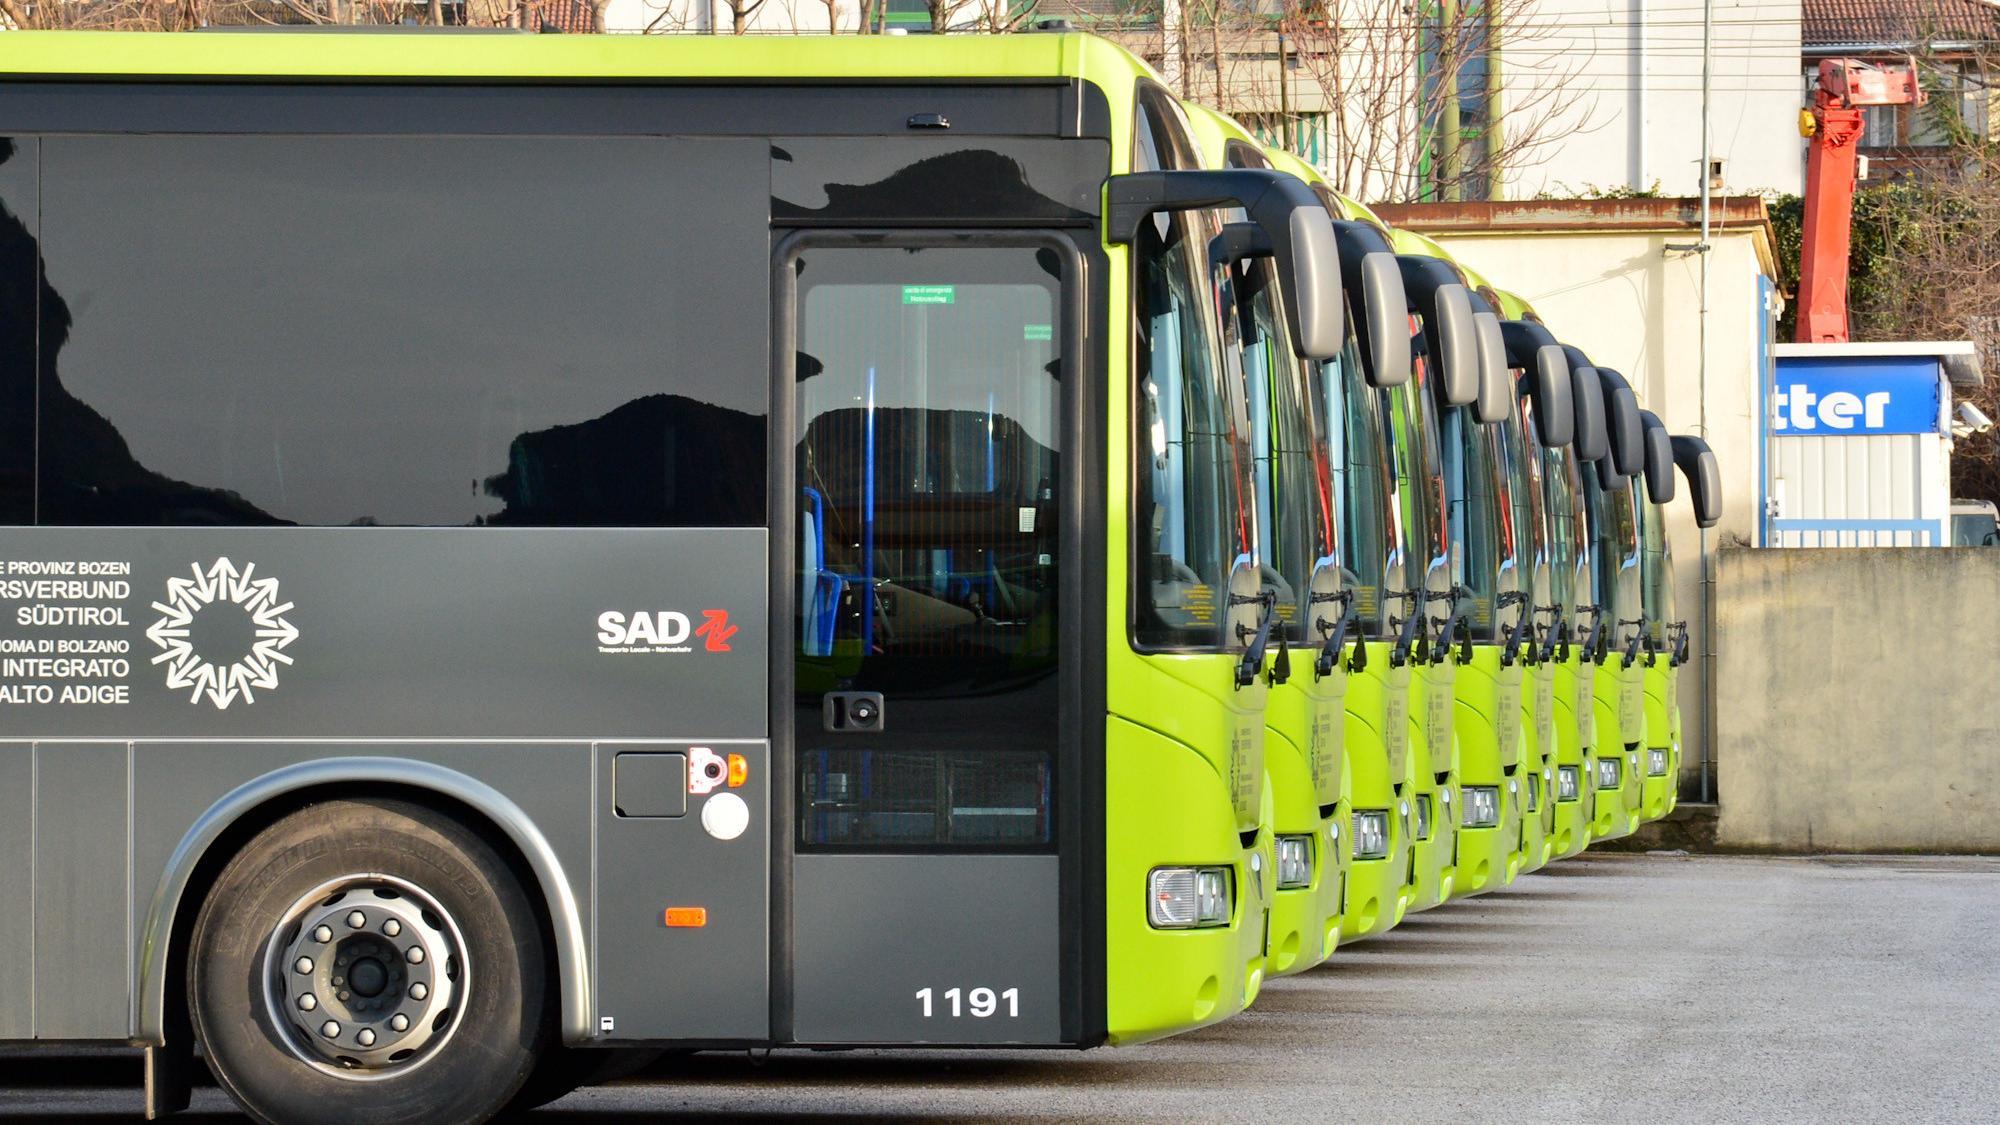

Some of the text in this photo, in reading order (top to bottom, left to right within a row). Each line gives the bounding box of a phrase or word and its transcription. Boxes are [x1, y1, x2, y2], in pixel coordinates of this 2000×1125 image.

[8, 561, 76, 576] PROVINZ
[78, 561, 131, 576] BOZEN
[16, 603, 130, 626] SÜDTIROL
[597, 610, 691, 646] SAD
[0, 639, 130, 654] OMA DI BOLZANO
[3, 658, 130, 678] INTEGRATO
[0, 684, 130, 704] ALTO ADIGE
[915, 987, 1019, 1018] 1191
